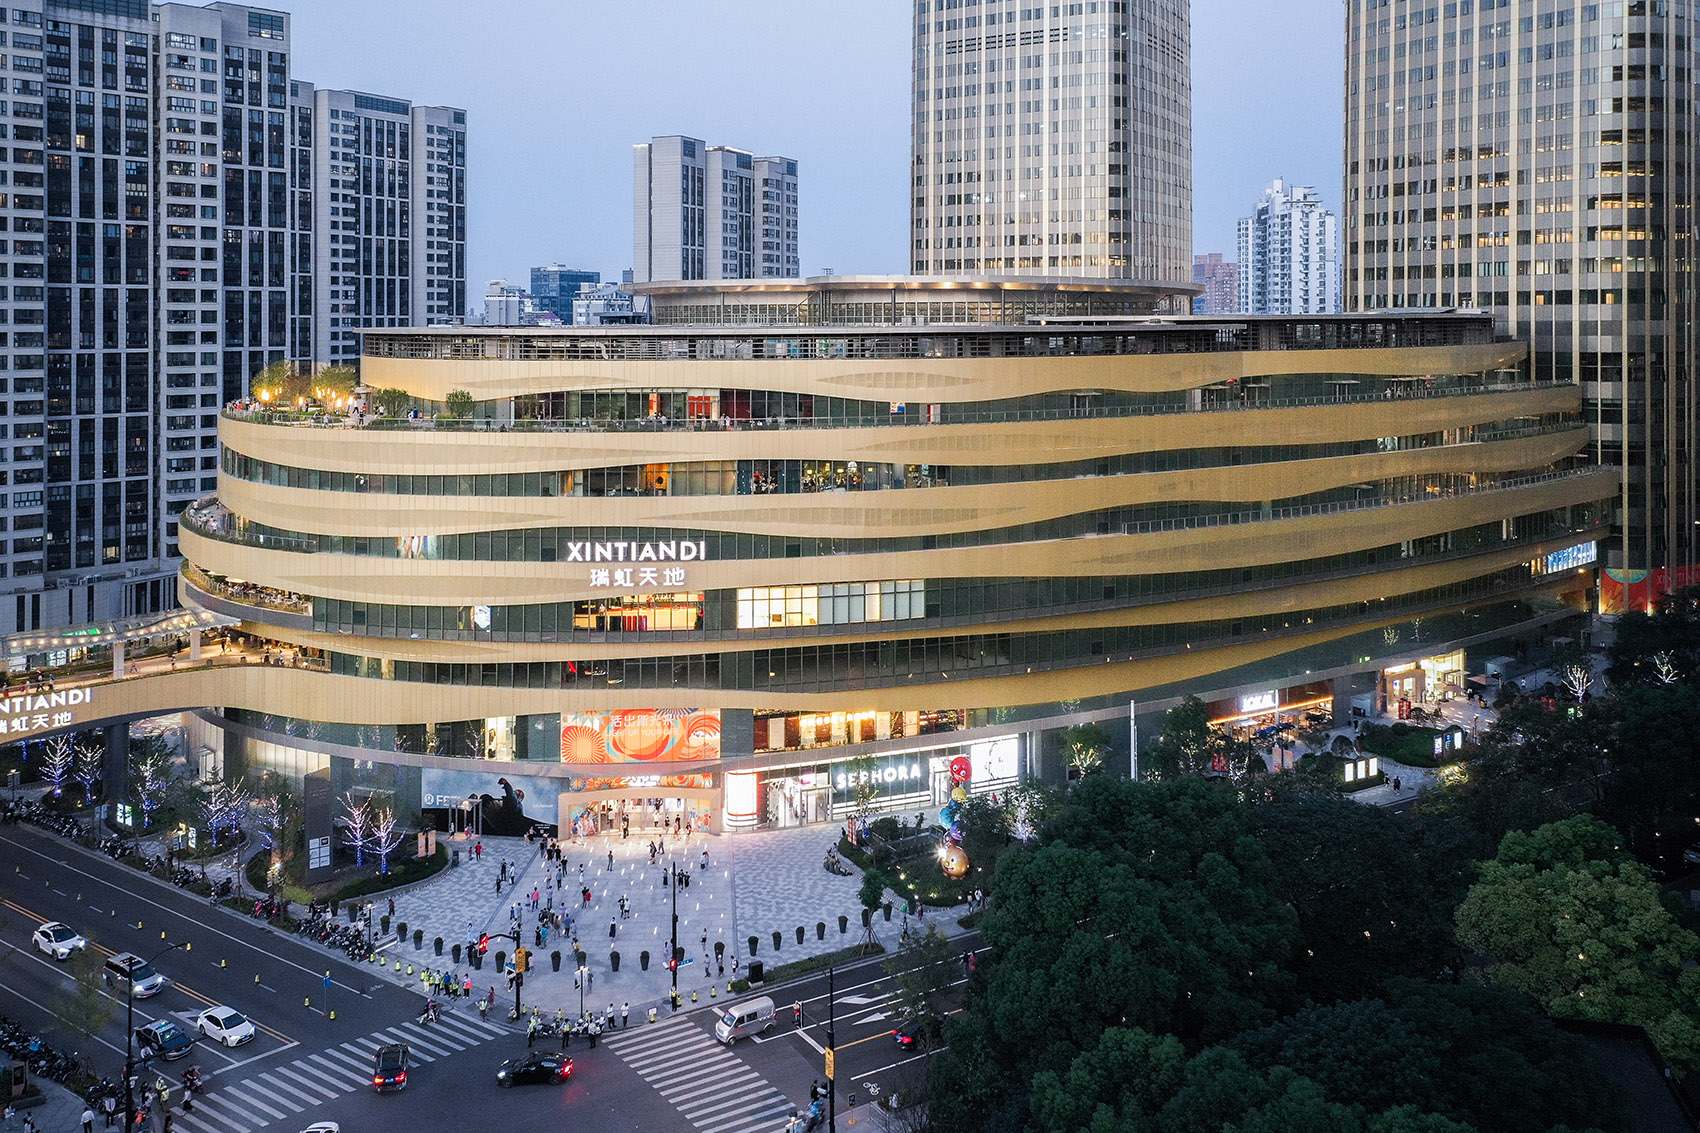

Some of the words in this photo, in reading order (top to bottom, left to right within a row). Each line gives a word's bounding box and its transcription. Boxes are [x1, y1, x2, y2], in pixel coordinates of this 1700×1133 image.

[567, 541, 705, 561] XINTIANDI
[589, 566, 685, 587] 瑞虹天地
[641, 728, 662, 736] YOUR
[837, 764, 921, 789] SEPHORA
